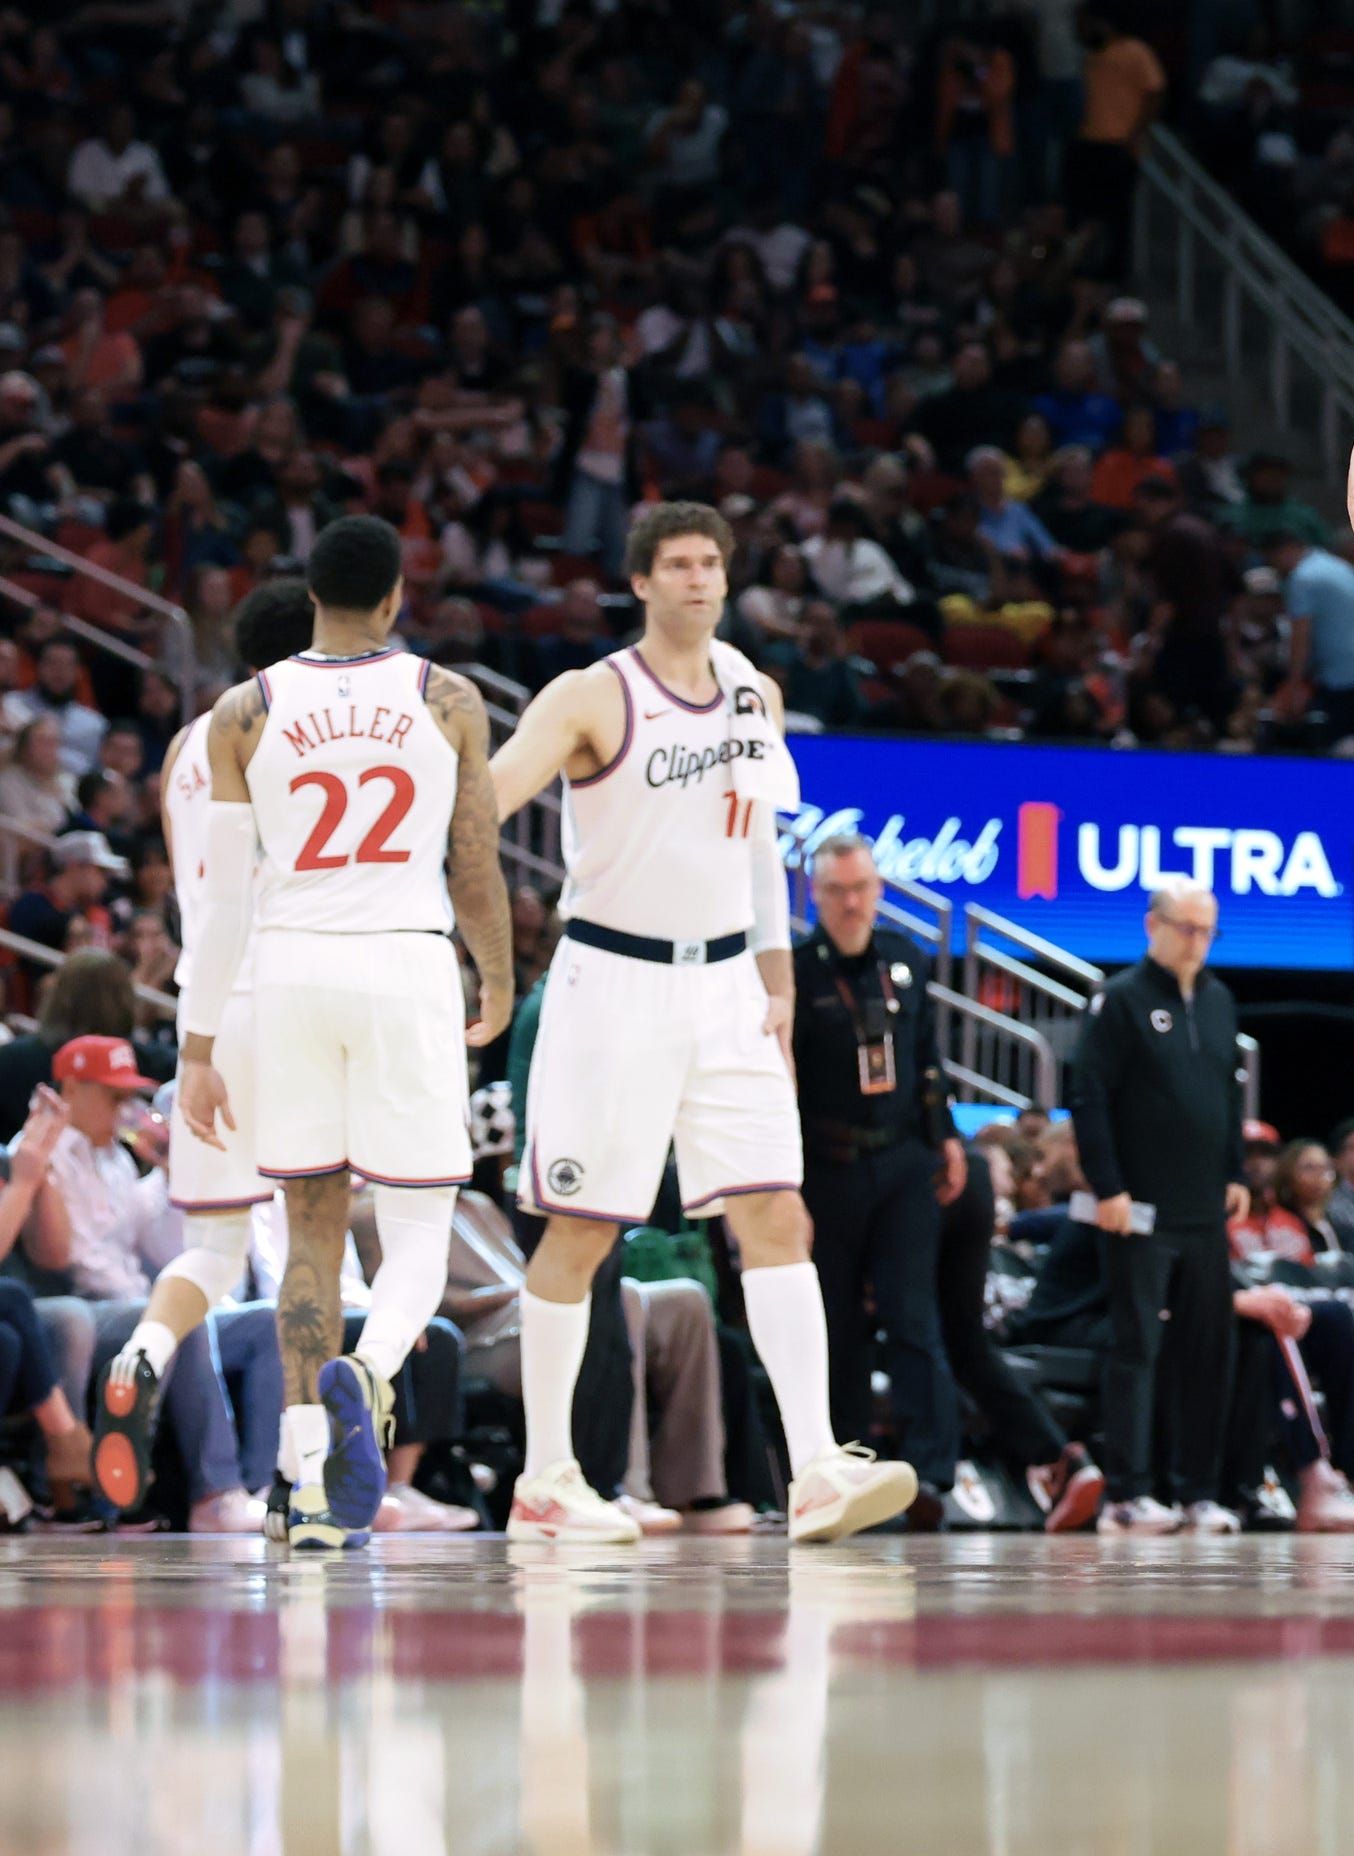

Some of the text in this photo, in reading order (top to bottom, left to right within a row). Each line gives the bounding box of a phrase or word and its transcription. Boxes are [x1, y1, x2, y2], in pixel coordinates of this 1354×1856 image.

[281, 705, 414, 758] MILLER
[289, 765, 415, 871] 22
[1078, 821, 1338, 897] ULTRA
